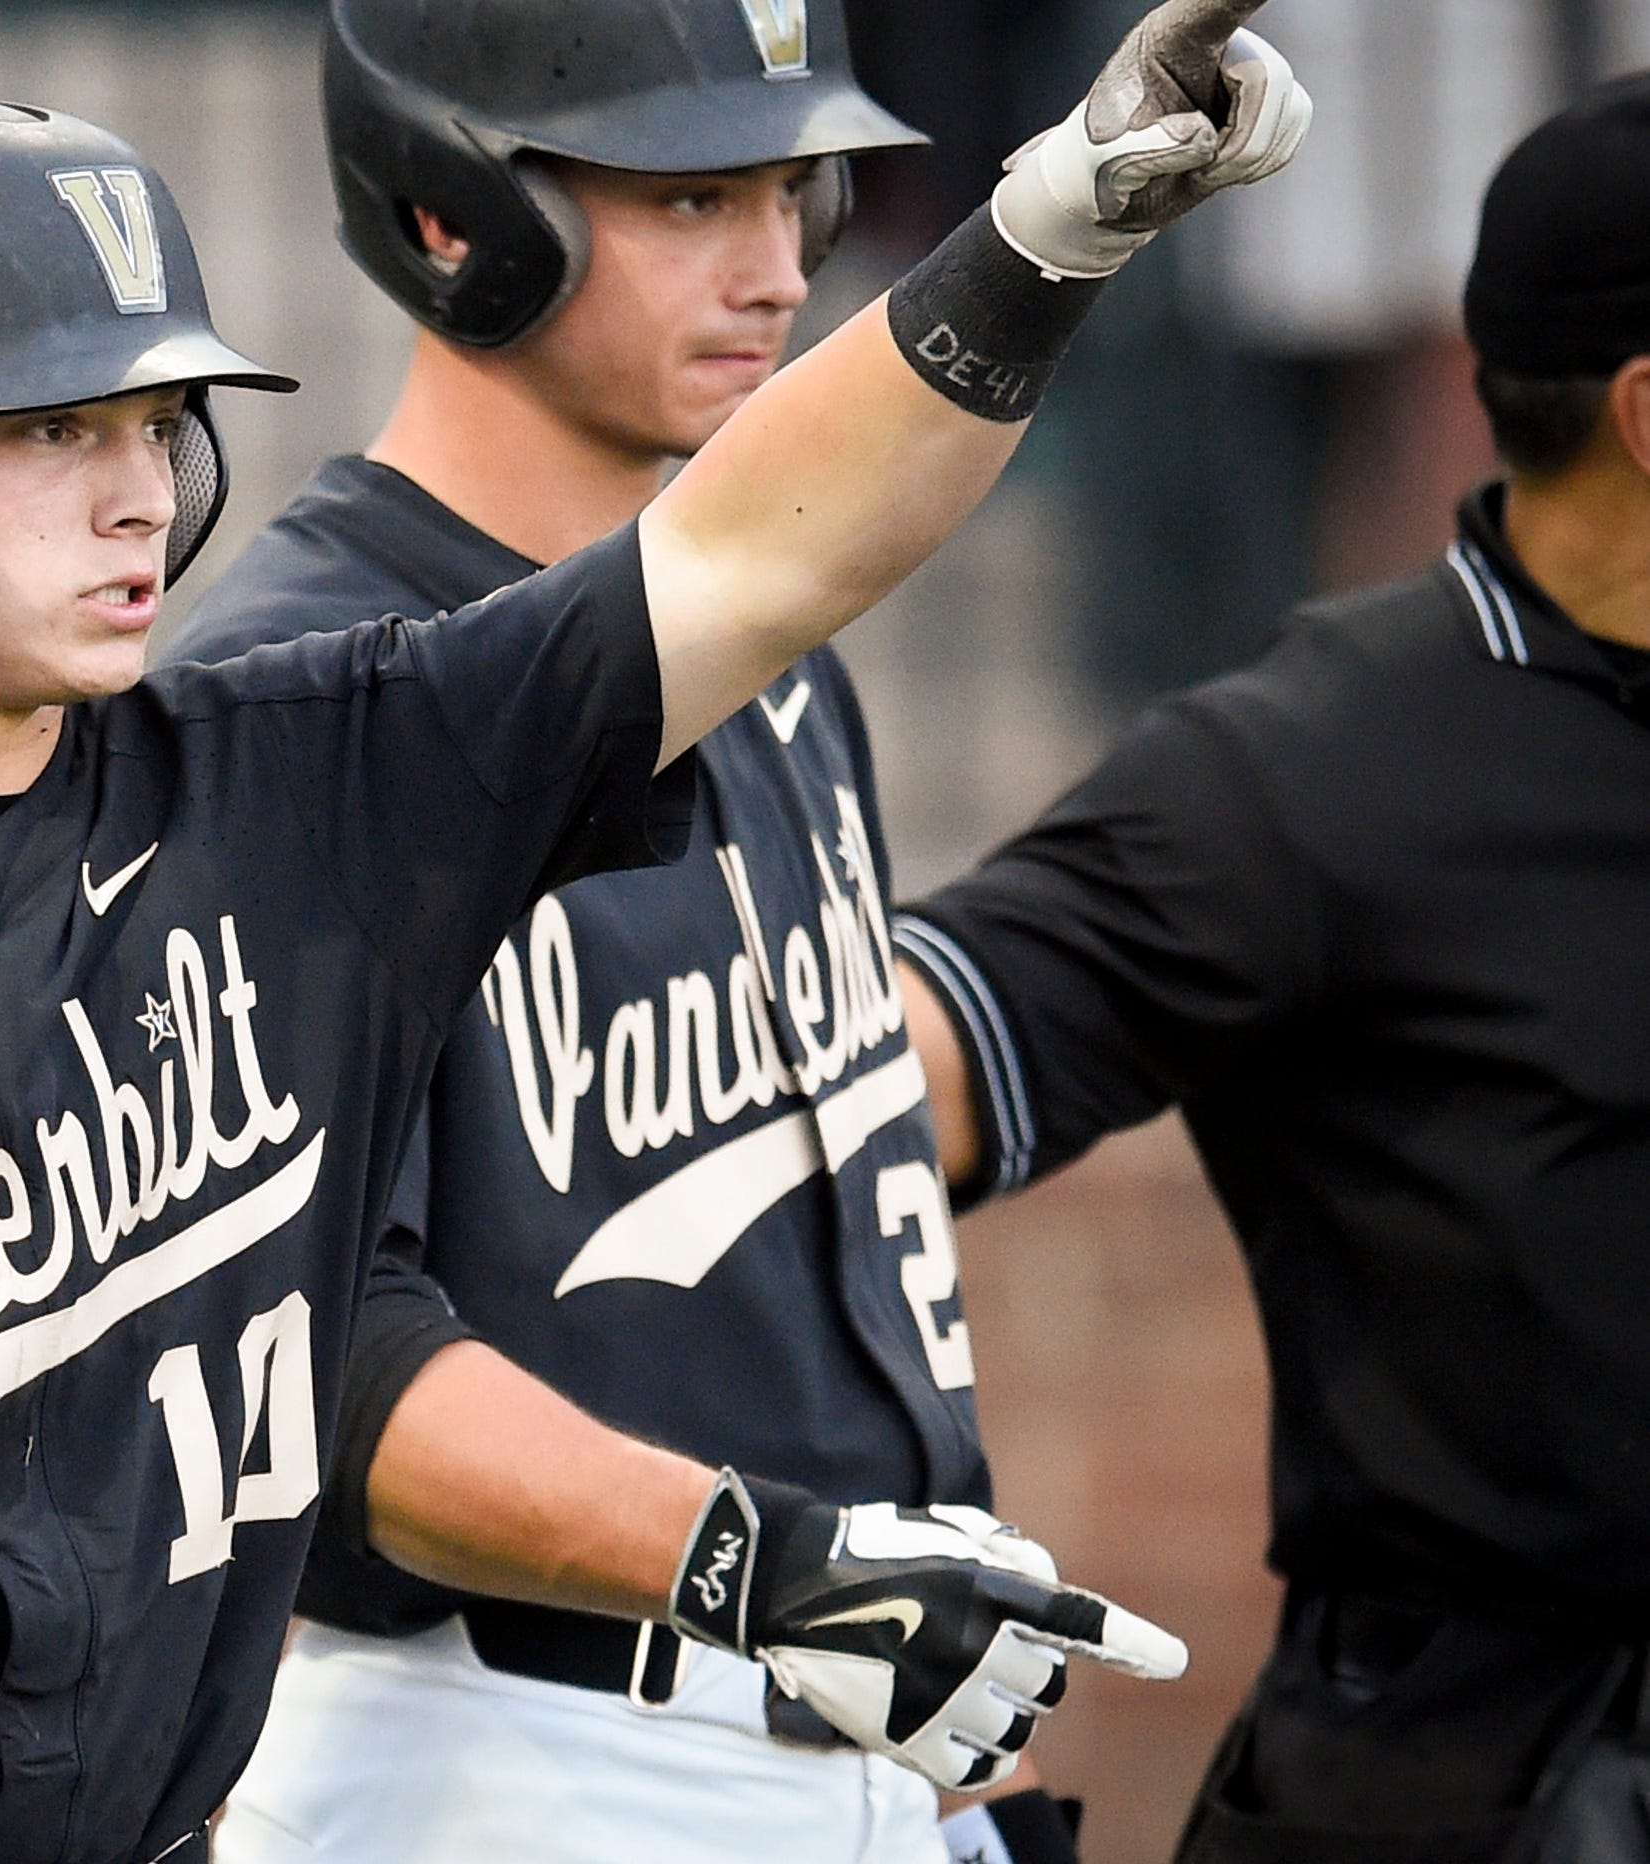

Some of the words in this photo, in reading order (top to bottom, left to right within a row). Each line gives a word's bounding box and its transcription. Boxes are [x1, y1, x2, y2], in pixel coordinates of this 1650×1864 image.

[48, 166, 166, 314] V
[876, 1160, 976, 1391] 2
[148, 1290, 321, 1586] 10
